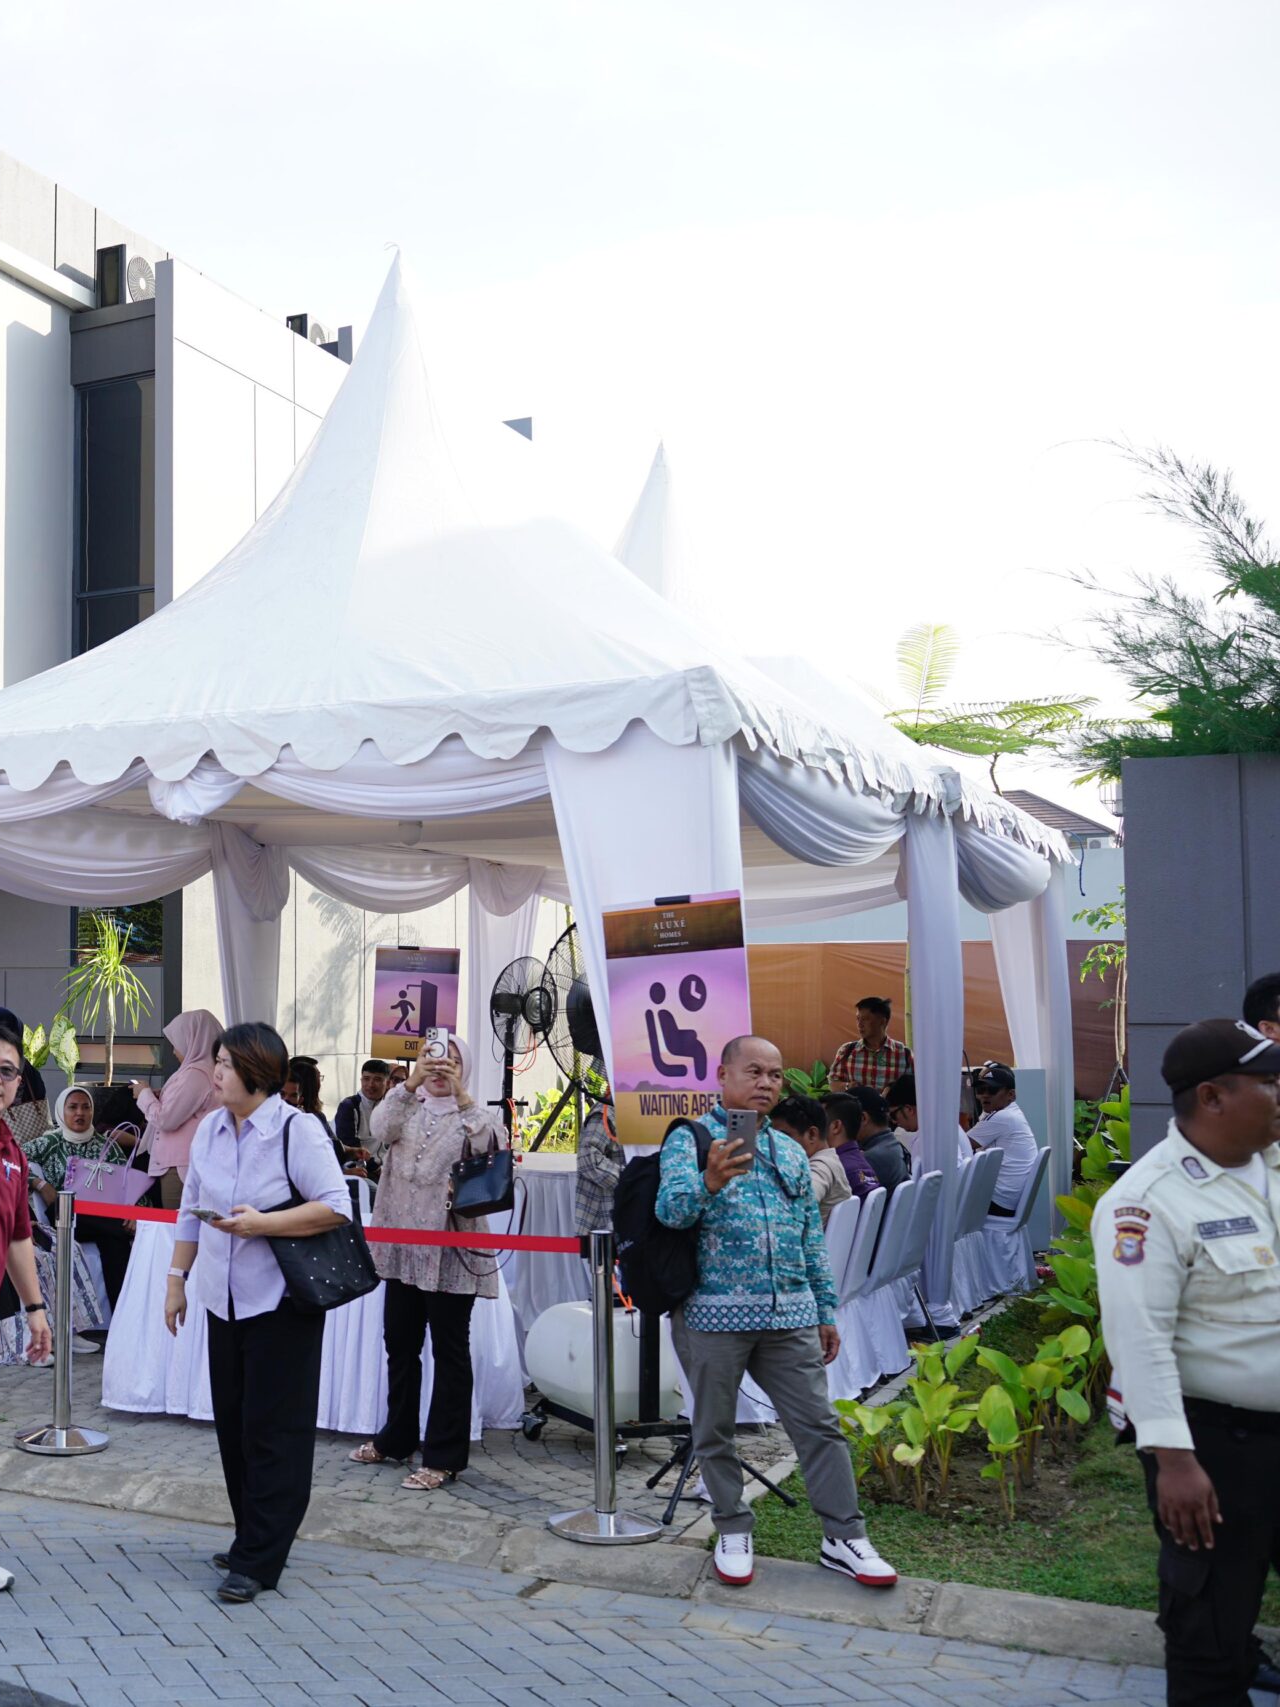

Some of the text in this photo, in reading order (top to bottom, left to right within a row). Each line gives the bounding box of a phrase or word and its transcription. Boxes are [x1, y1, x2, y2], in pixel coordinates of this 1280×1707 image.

[405, 1040, 419, 1051] EXIT
[639, 1093, 721, 1116] WAITING ARE
